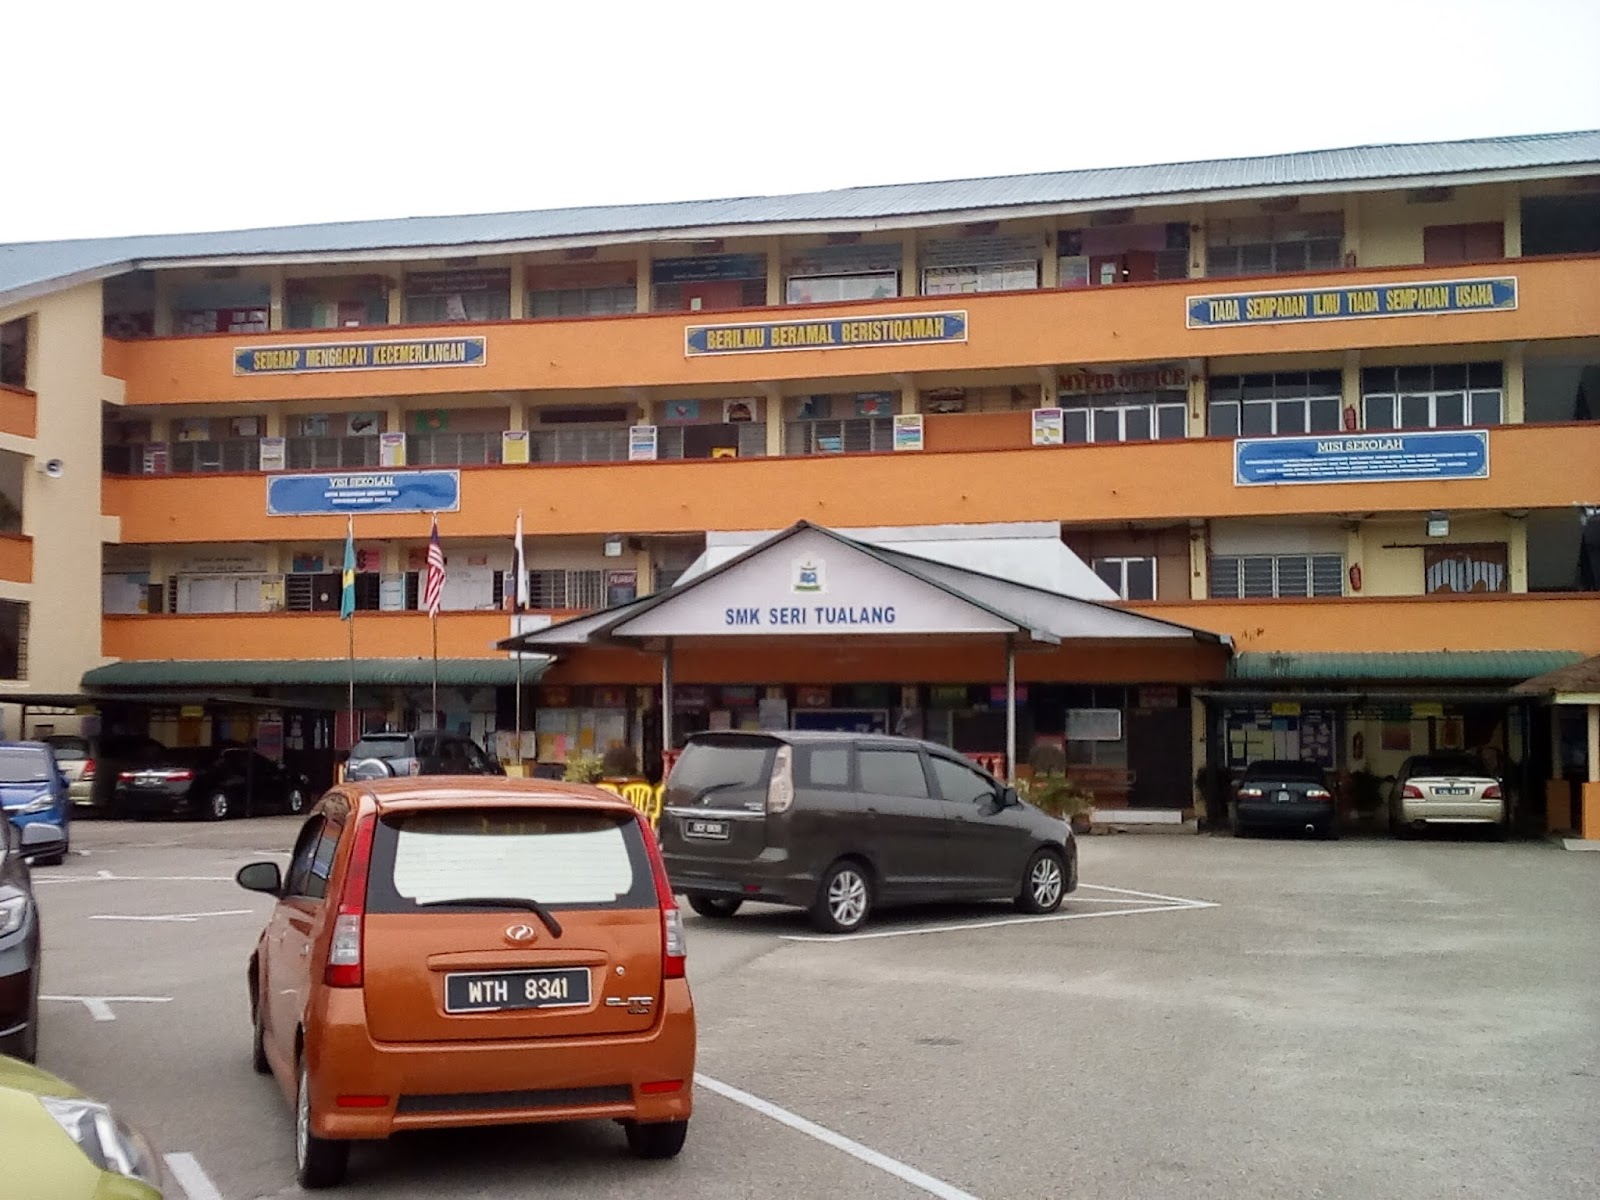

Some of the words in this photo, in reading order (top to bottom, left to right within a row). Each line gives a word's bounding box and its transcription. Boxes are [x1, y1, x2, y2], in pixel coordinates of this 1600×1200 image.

[1208, 300, 1240, 321] TIADA
[1246, 296, 1307, 320] SEMPADAN
[1313, 293, 1340, 316] ILMU
[1347, 291, 1379, 313] TIADA
[1385, 286, 1449, 311] SEMPADAN
[1455, 284, 1494, 306] USAHA
[706, 328, 765, 350] BERILMU
[770, 324, 835, 347] BERAMAL
[841, 317, 945, 343] BERISTIQAMAH
[253, 350, 300, 370] SEDERAP
[305, 346, 368, 368] MENGGAPAI
[372, 342, 466, 365] KECEMERLANGAN
[1317, 441, 1343, 453] MISI
[1346, 438, 1404, 452] SEKOLAH
[351, 475, 395, 488] SEKOLAH
[725, 608, 760, 625] SMK
[769, 607, 806, 625] SERI
[815, 606, 896, 624] TUALANG
[468, 980, 508, 1003] WTH
[525, 977, 569, 1000] 8341
